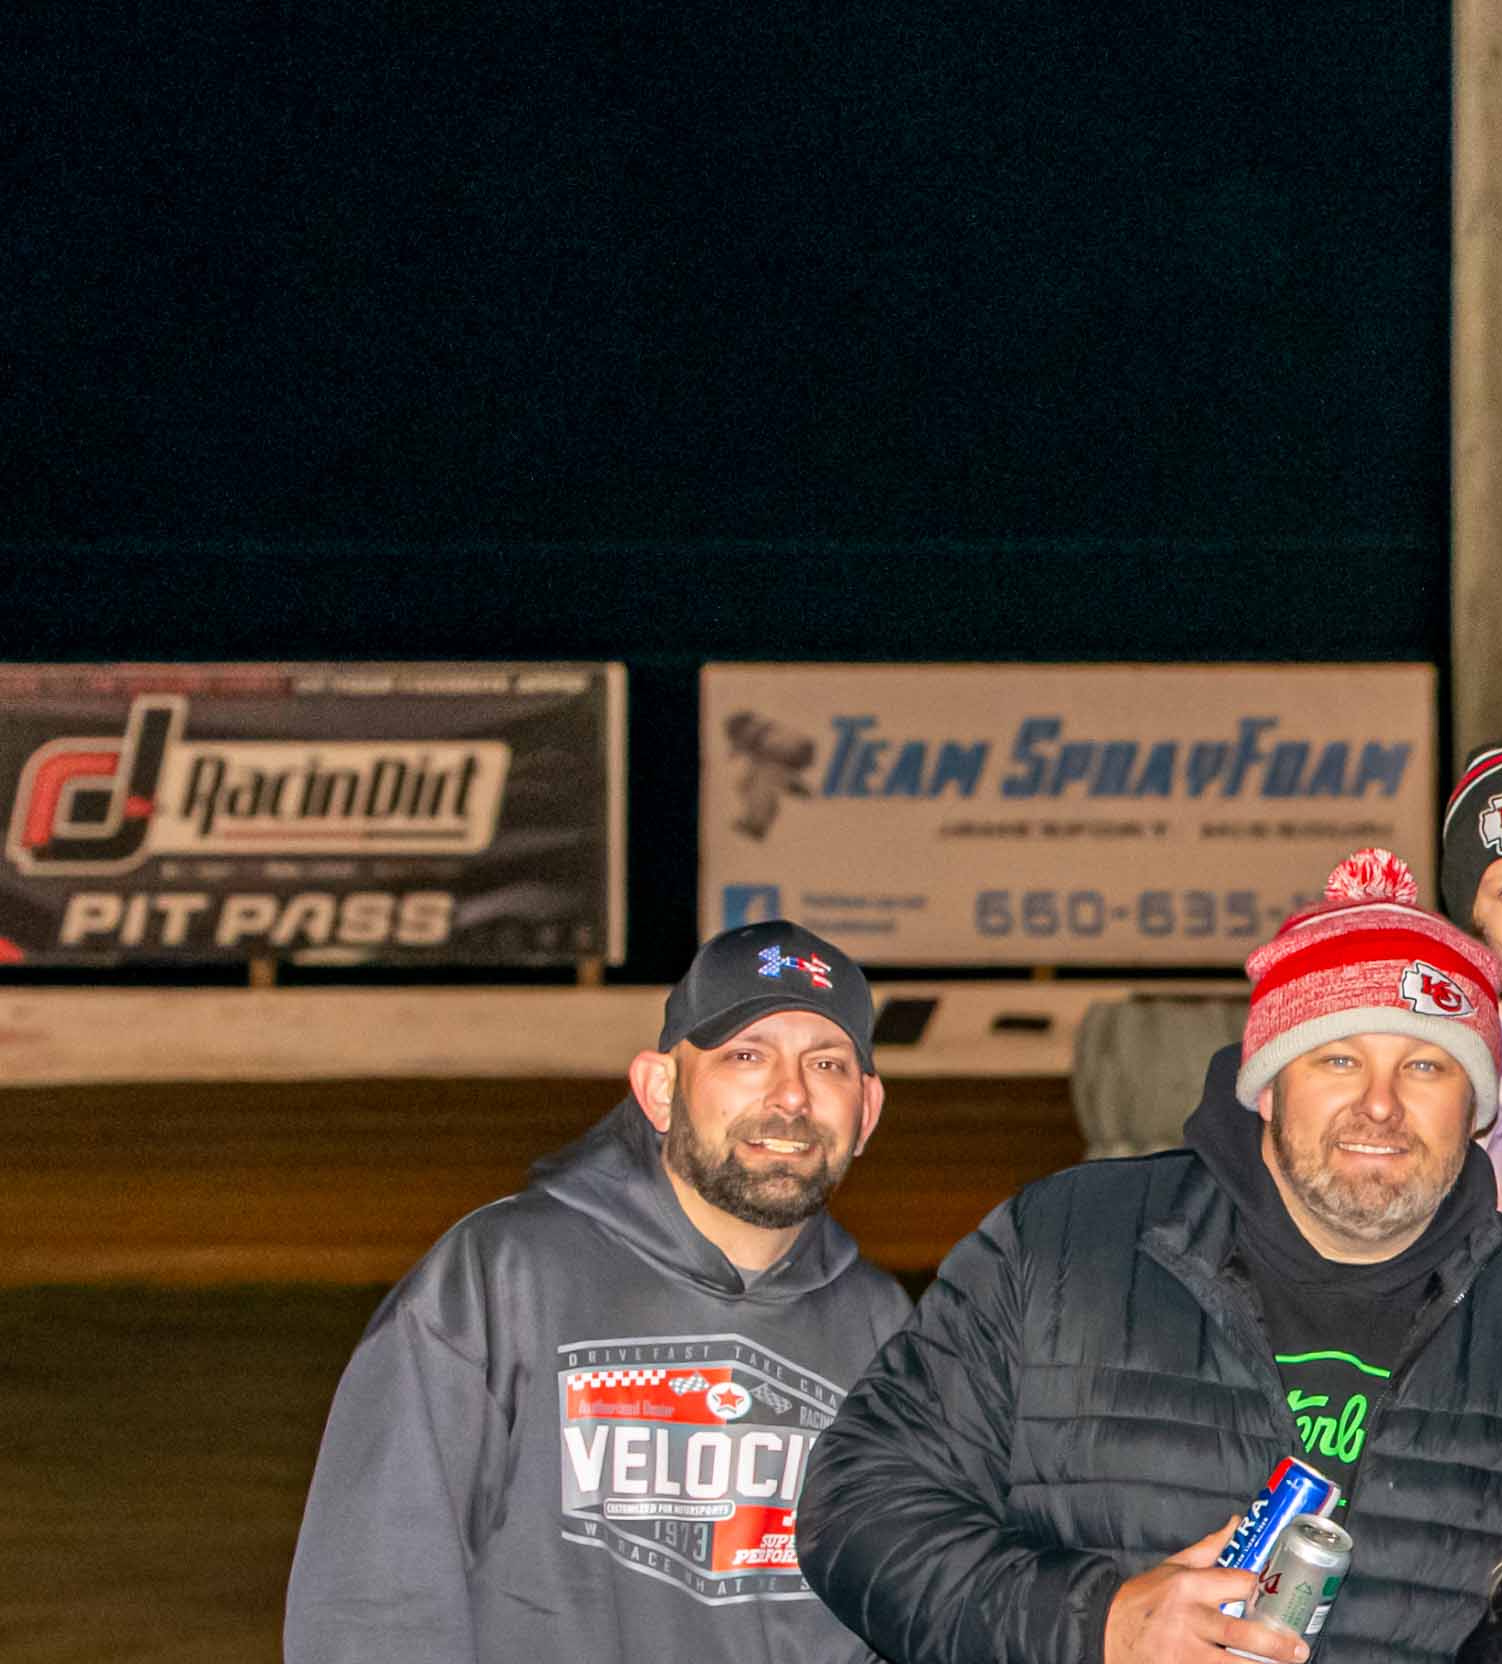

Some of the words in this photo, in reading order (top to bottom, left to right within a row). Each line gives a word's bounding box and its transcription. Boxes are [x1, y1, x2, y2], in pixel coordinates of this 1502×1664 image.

[61, 893, 210, 947] PIT
[215, 892, 455, 947] PASS
[974, 890, 1318, 938] 660-635-
[563, 1426, 818, 1499] VELOCI
[653, 1519, 708, 1562] 1973
[761, 1534, 796, 1548] SUPE
[1217, 1499, 1270, 1568] LTRA
